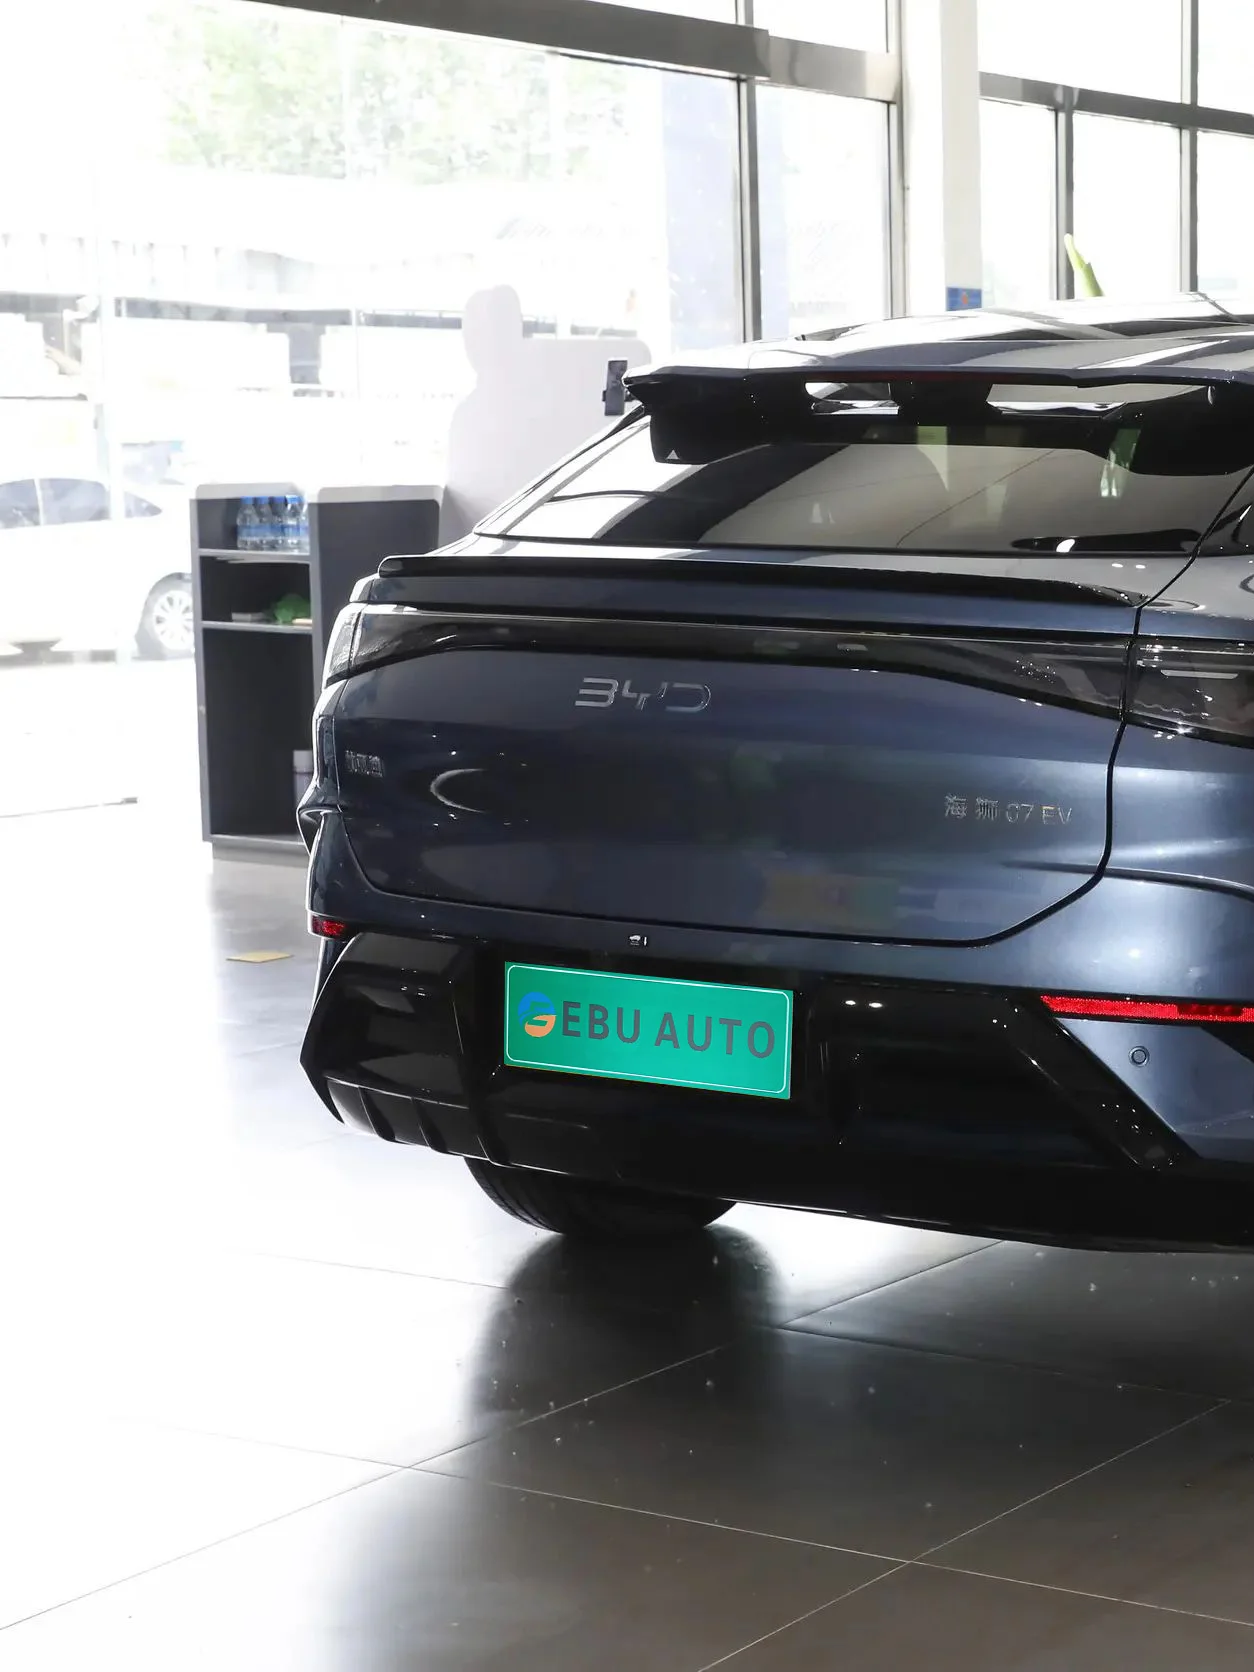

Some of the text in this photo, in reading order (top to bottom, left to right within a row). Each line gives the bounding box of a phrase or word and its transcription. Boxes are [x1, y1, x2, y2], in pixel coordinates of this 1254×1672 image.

[574, 677, 712, 713] BYD
[1042, 805, 1072, 824] EV
[654, 1012, 775, 1059] AUTO
